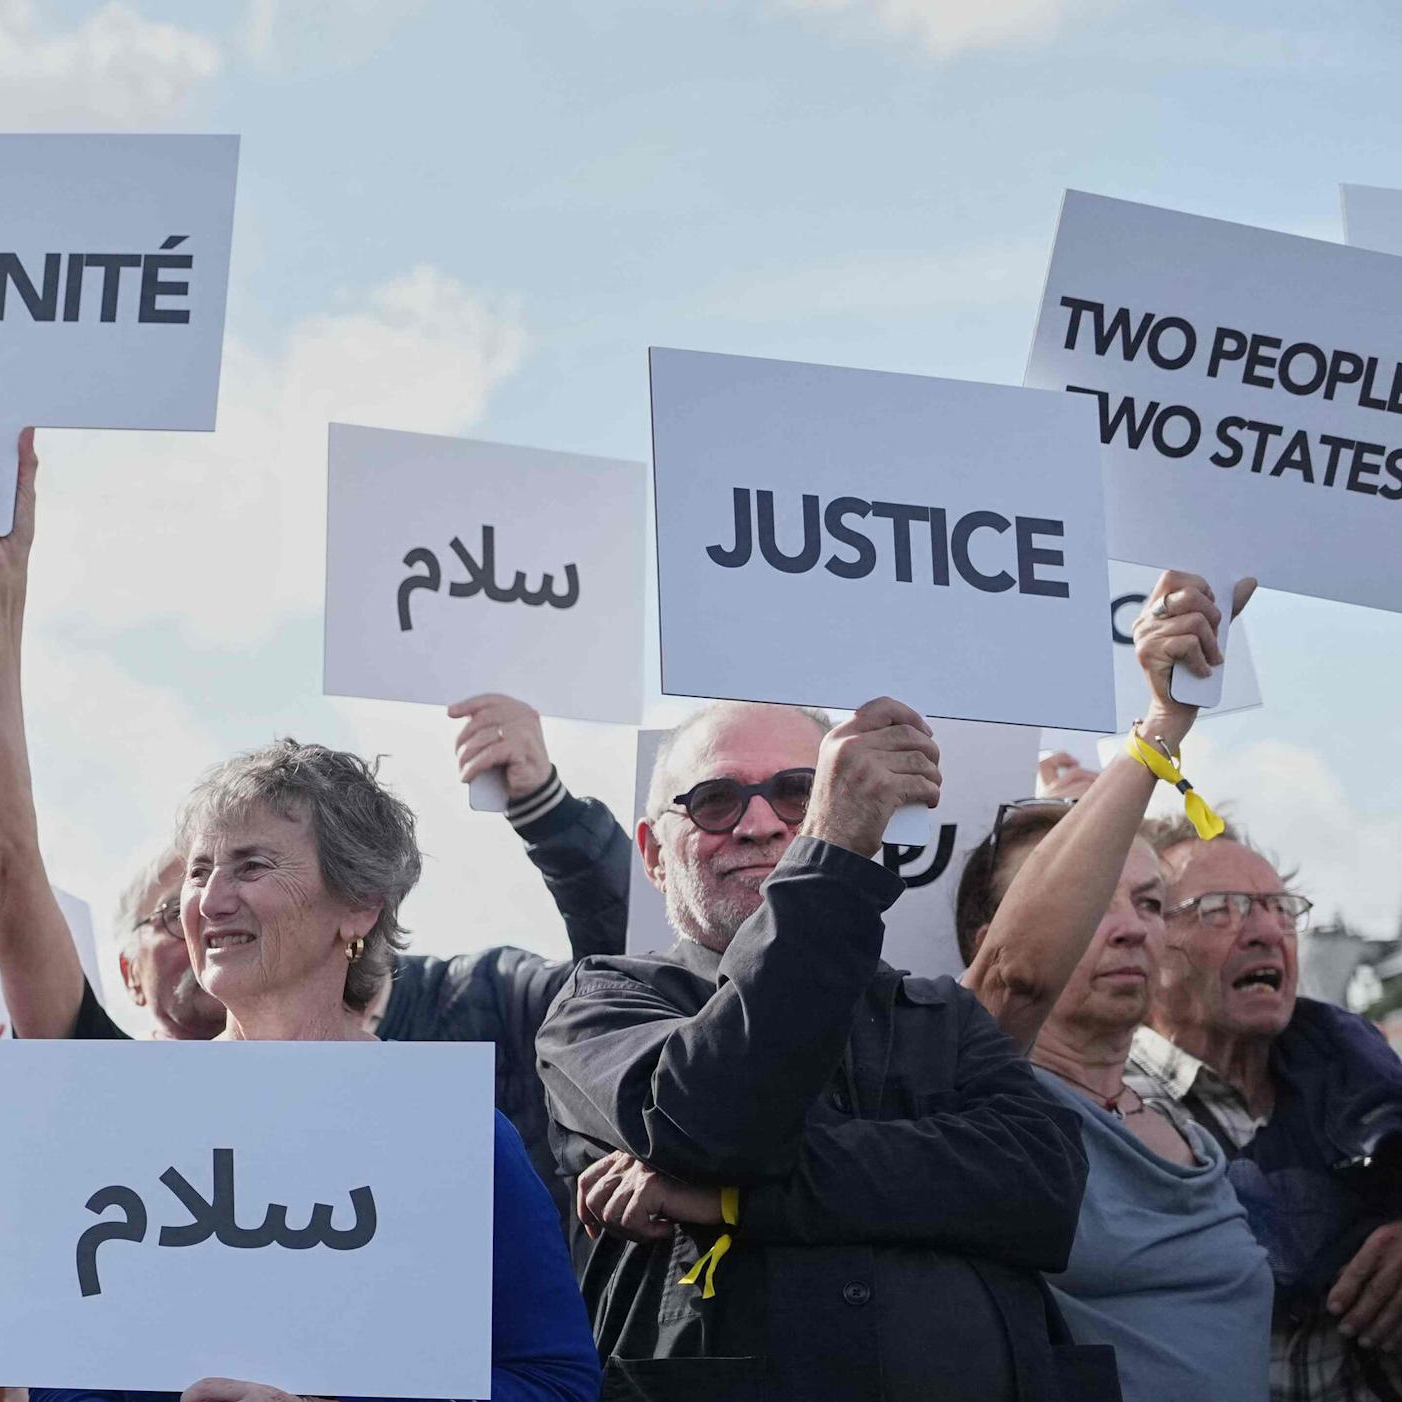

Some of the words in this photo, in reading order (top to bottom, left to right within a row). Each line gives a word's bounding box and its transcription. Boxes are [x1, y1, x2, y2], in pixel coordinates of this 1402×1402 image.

[1059, 295, 1197, 371] TWO
[1065, 384, 1202, 459] WO
[396, 524, 580, 632] سلام
[705, 486, 1070, 599] JUSTICE
[75, 1147, 378, 1298] سلام
